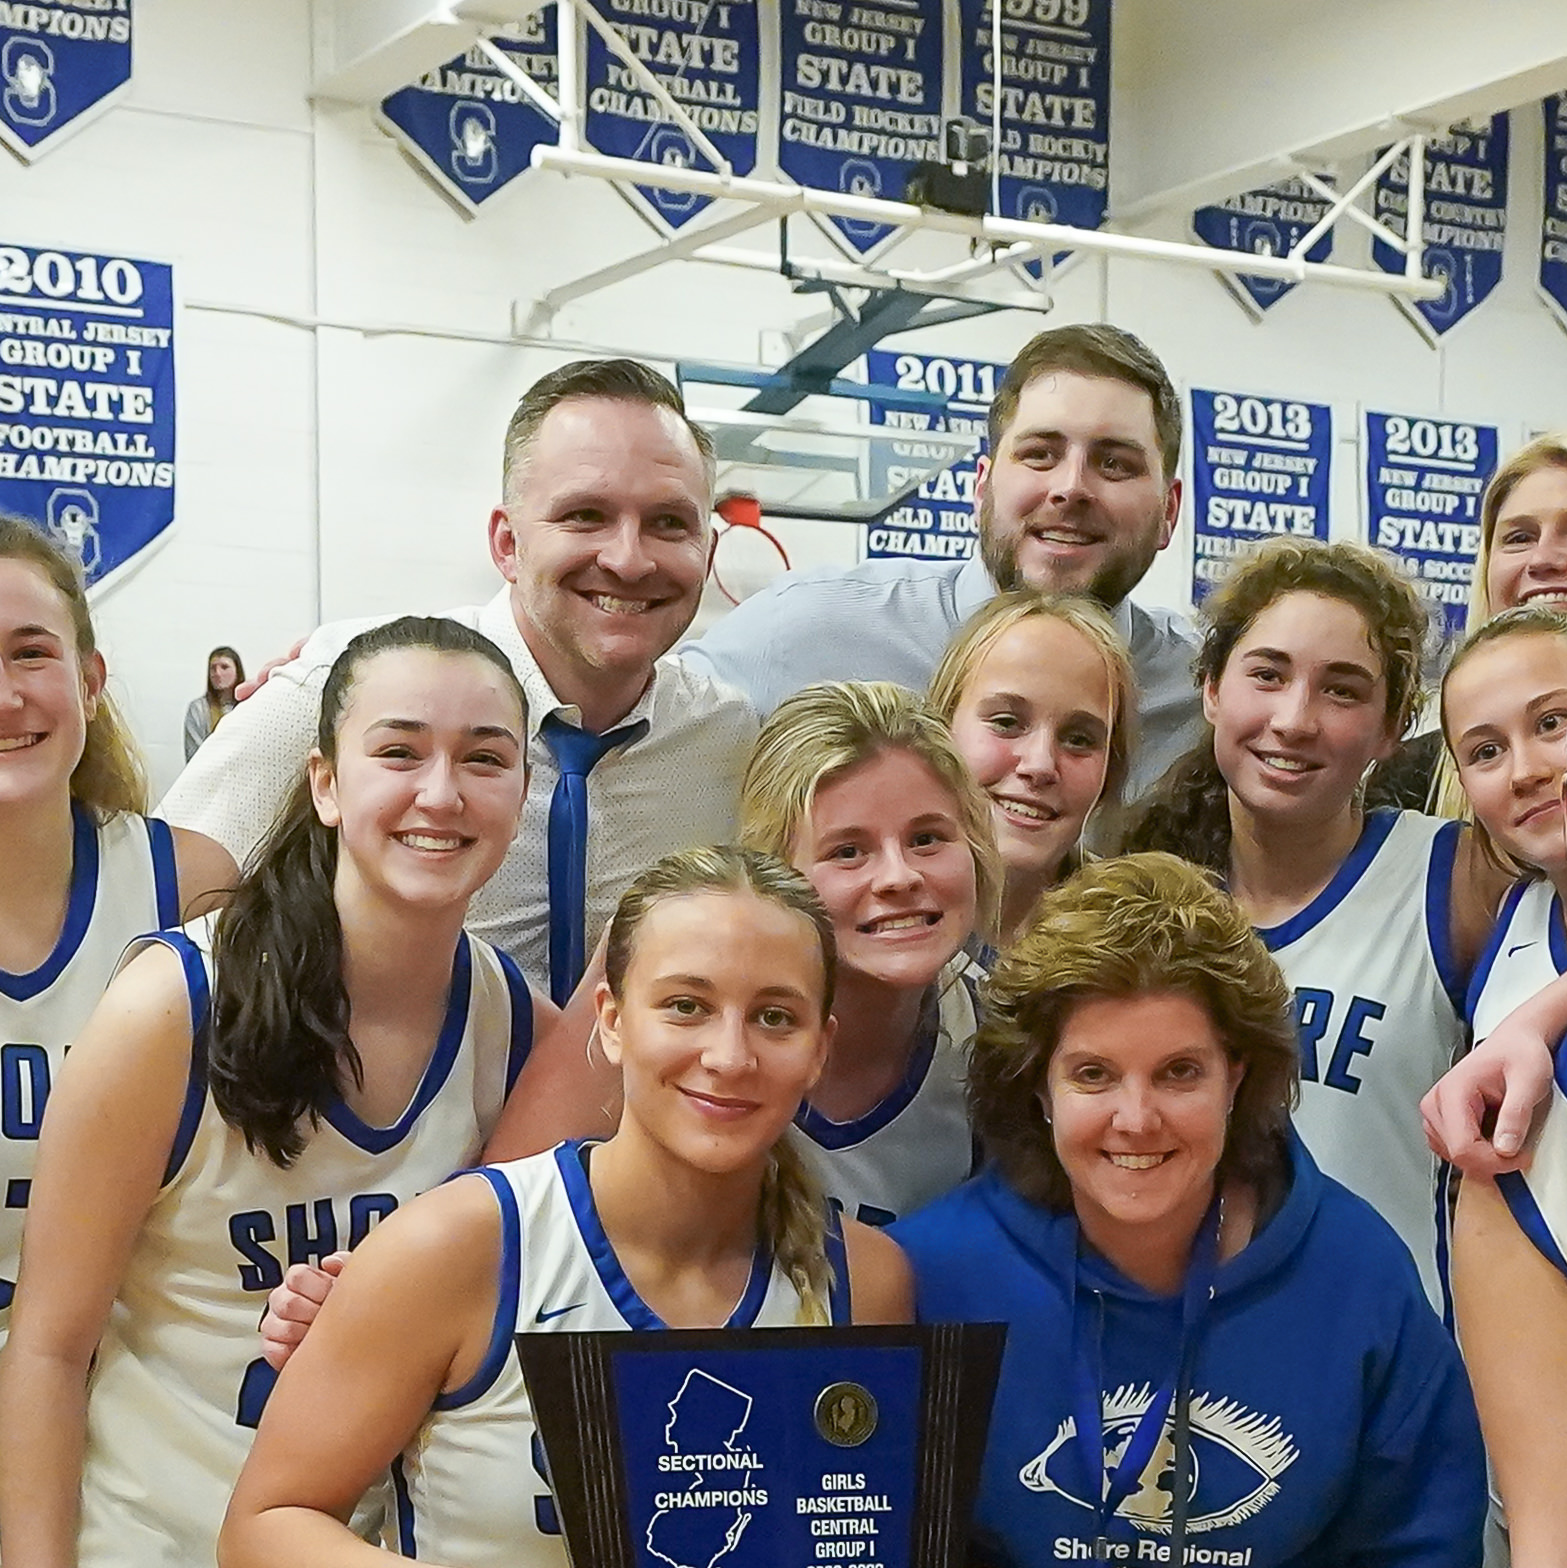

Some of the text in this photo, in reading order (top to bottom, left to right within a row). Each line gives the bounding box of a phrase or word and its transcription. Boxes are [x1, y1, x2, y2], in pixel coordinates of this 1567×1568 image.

[718, 5, 730, 28] I
[608, 21, 738, 73] TATE
[804, 21, 916, 61] GROUP I
[797, 53, 924, 104] STATE
[1079, 67, 1090, 88] I
[784, 91, 846, 124] FIELD
[976, 82, 1096, 129] STATE
[83, 322, 172, 348] JERSEY
[0, 338, 142, 376] GROUP I
[895, 356, 996, 402] 2011
[885, 411, 930, 431] NEW
[1214, 394, 1312, 440] 2013
[1385, 417, 1479, 461] 2013
[1214, 468, 1308, 497] GROUP I
[1207, 497, 1315, 535] STATE
[1385, 488, 1475, 517] GROUP I
[1377, 515, 1480, 555] STATE
[658, 1453, 763, 1472] SECTIONAL
[822, 1474, 866, 1490] GIRLS
[654, 1489, 768, 1509] CHAMPIONS
[796, 1495, 892, 1515] BASKETBALL
[811, 1518, 878, 1536] CENTRAL
[816, 1541, 875, 1559] GROUP I
[1053, 1537, 1252, 1566] Shre Reional
